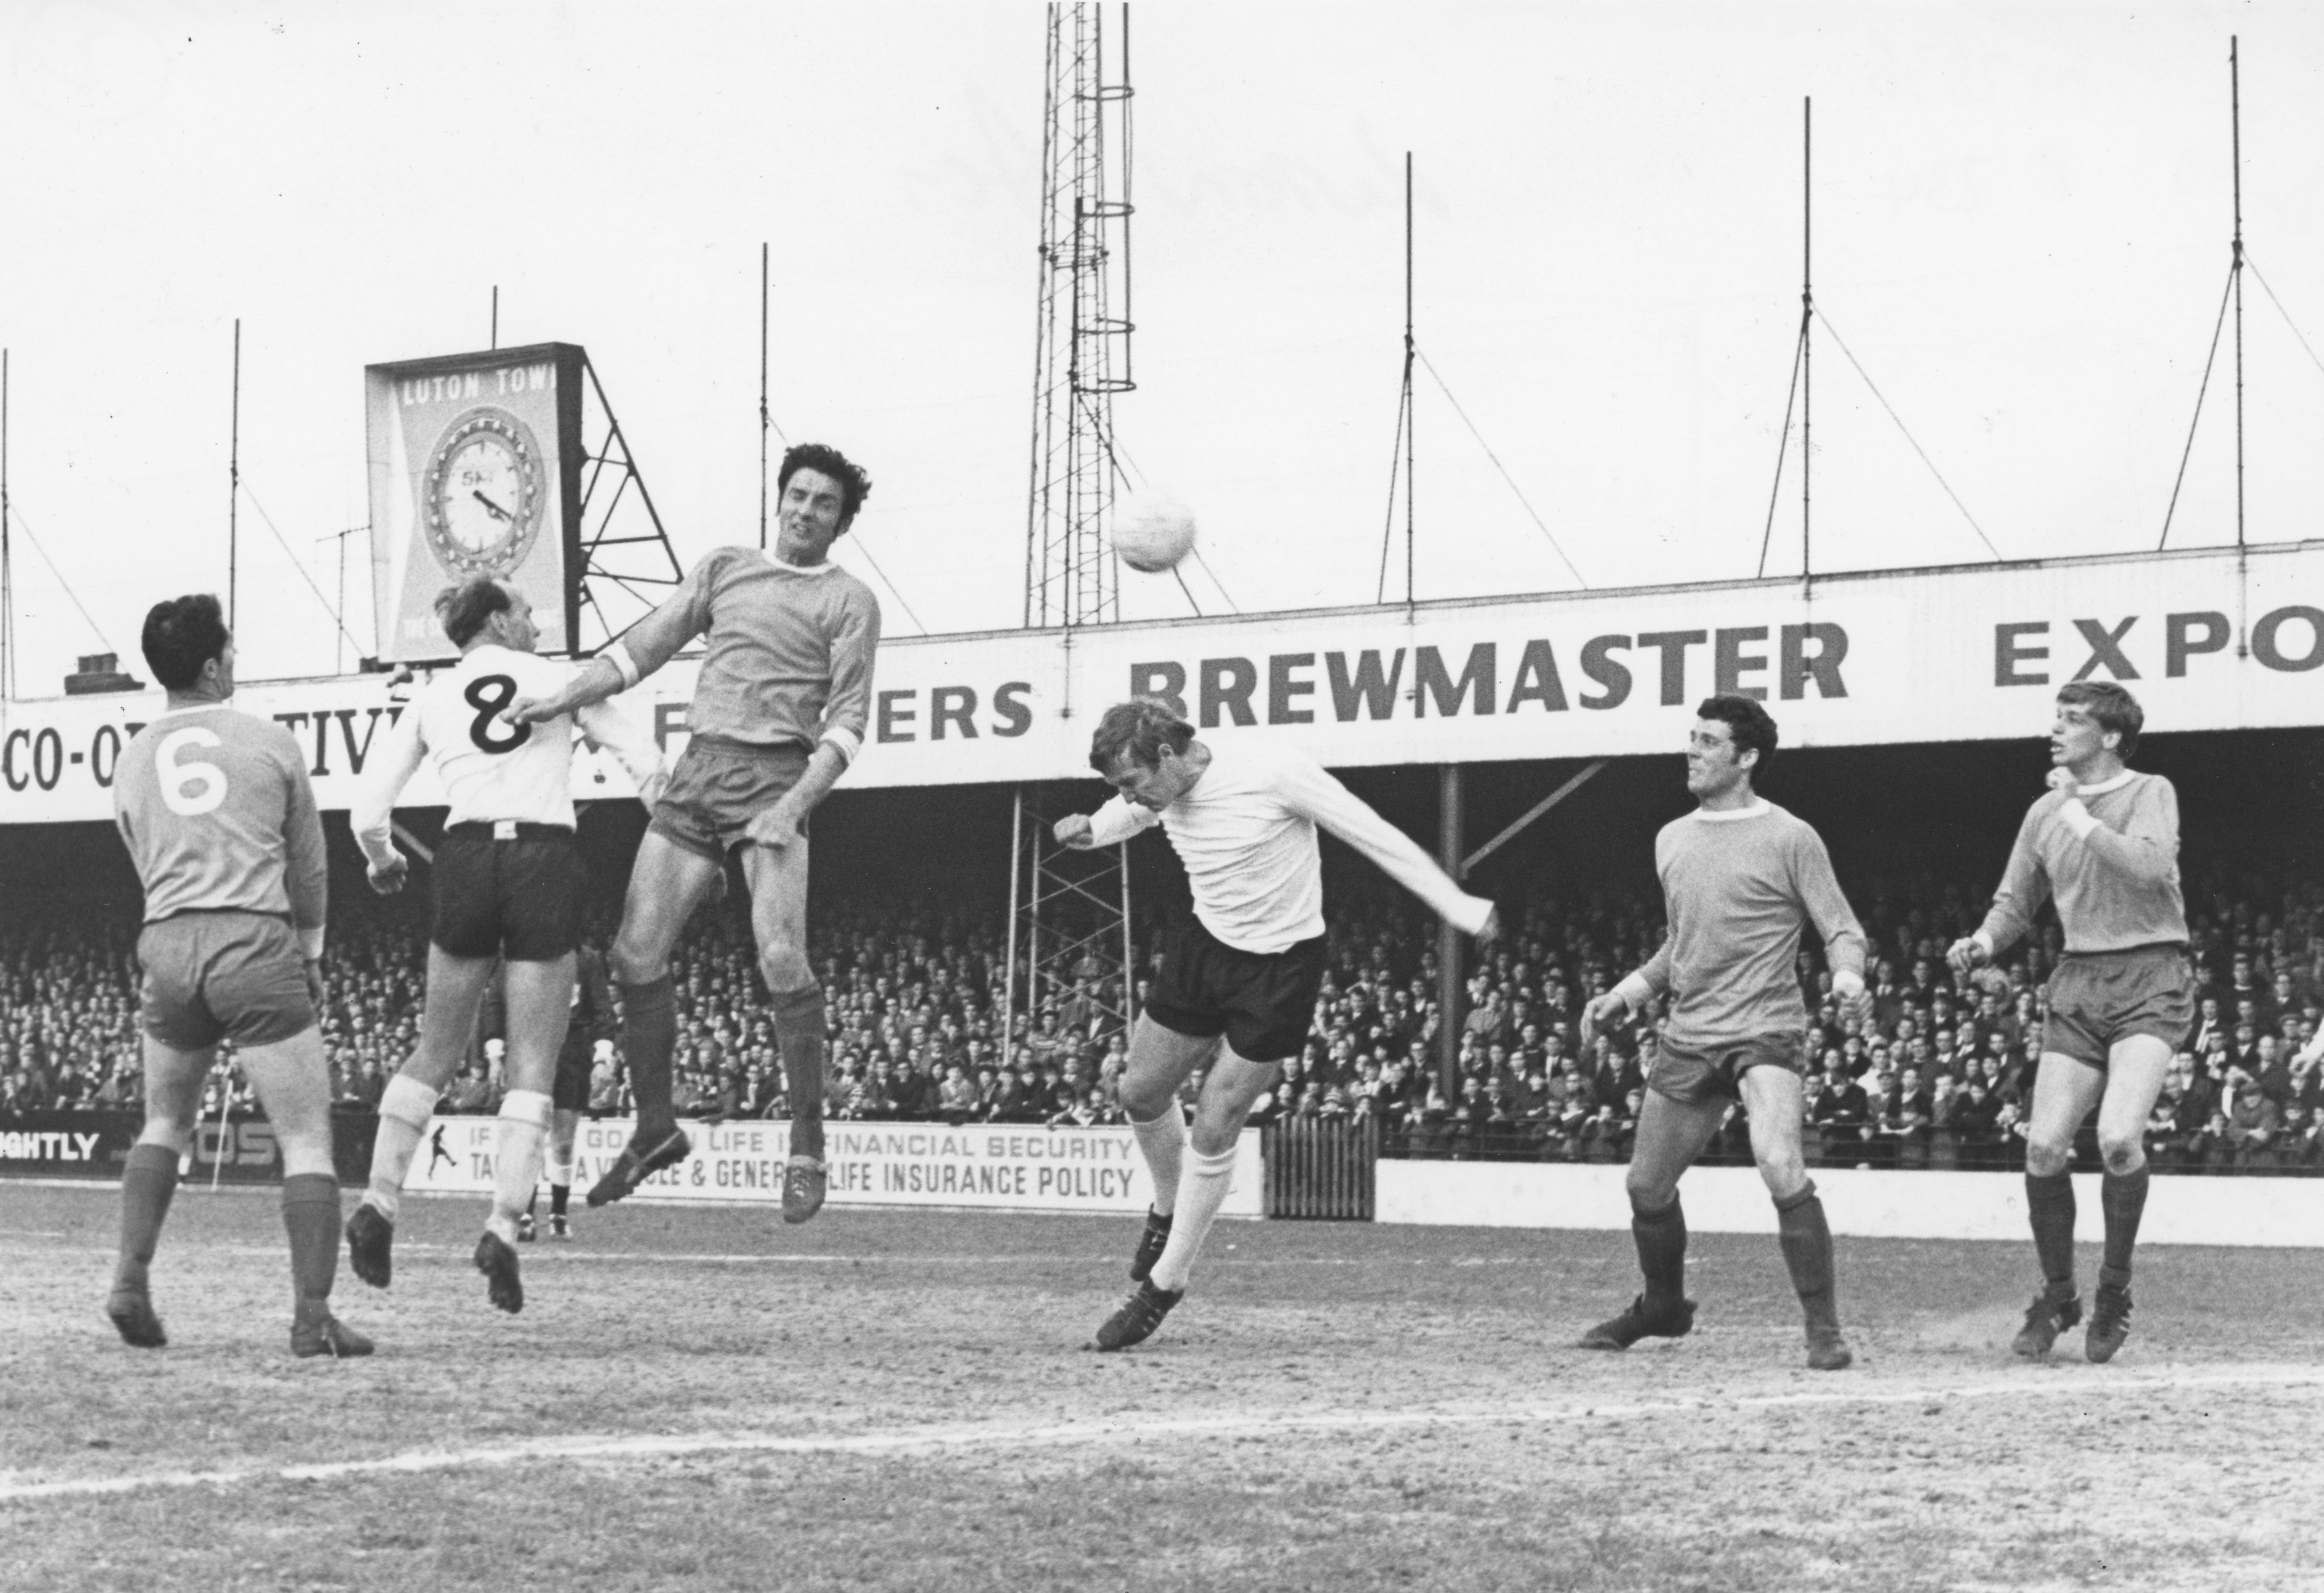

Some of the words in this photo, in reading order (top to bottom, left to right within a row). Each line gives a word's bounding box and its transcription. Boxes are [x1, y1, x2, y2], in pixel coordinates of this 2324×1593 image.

[403, 371, 479, 406] LUTON
[1130, 622, 1849, 729] BREWMASTER
[464, 674, 532, 754] 8
[155, 726, 228, 816] 6
[470, 1127, 490, 1146] IF
[710, 1130, 764, 1153] LIFE
[987, 1136, 1133, 1160] SECURITY
[575, 1156, 589, 1183] A
[691, 1159, 706, 1187] &
[828, 1162, 872, 1192] LIFE
[884, 1162, 1026, 1196] INSURANCE
[1038, 1166, 1134, 1198] POLICY
